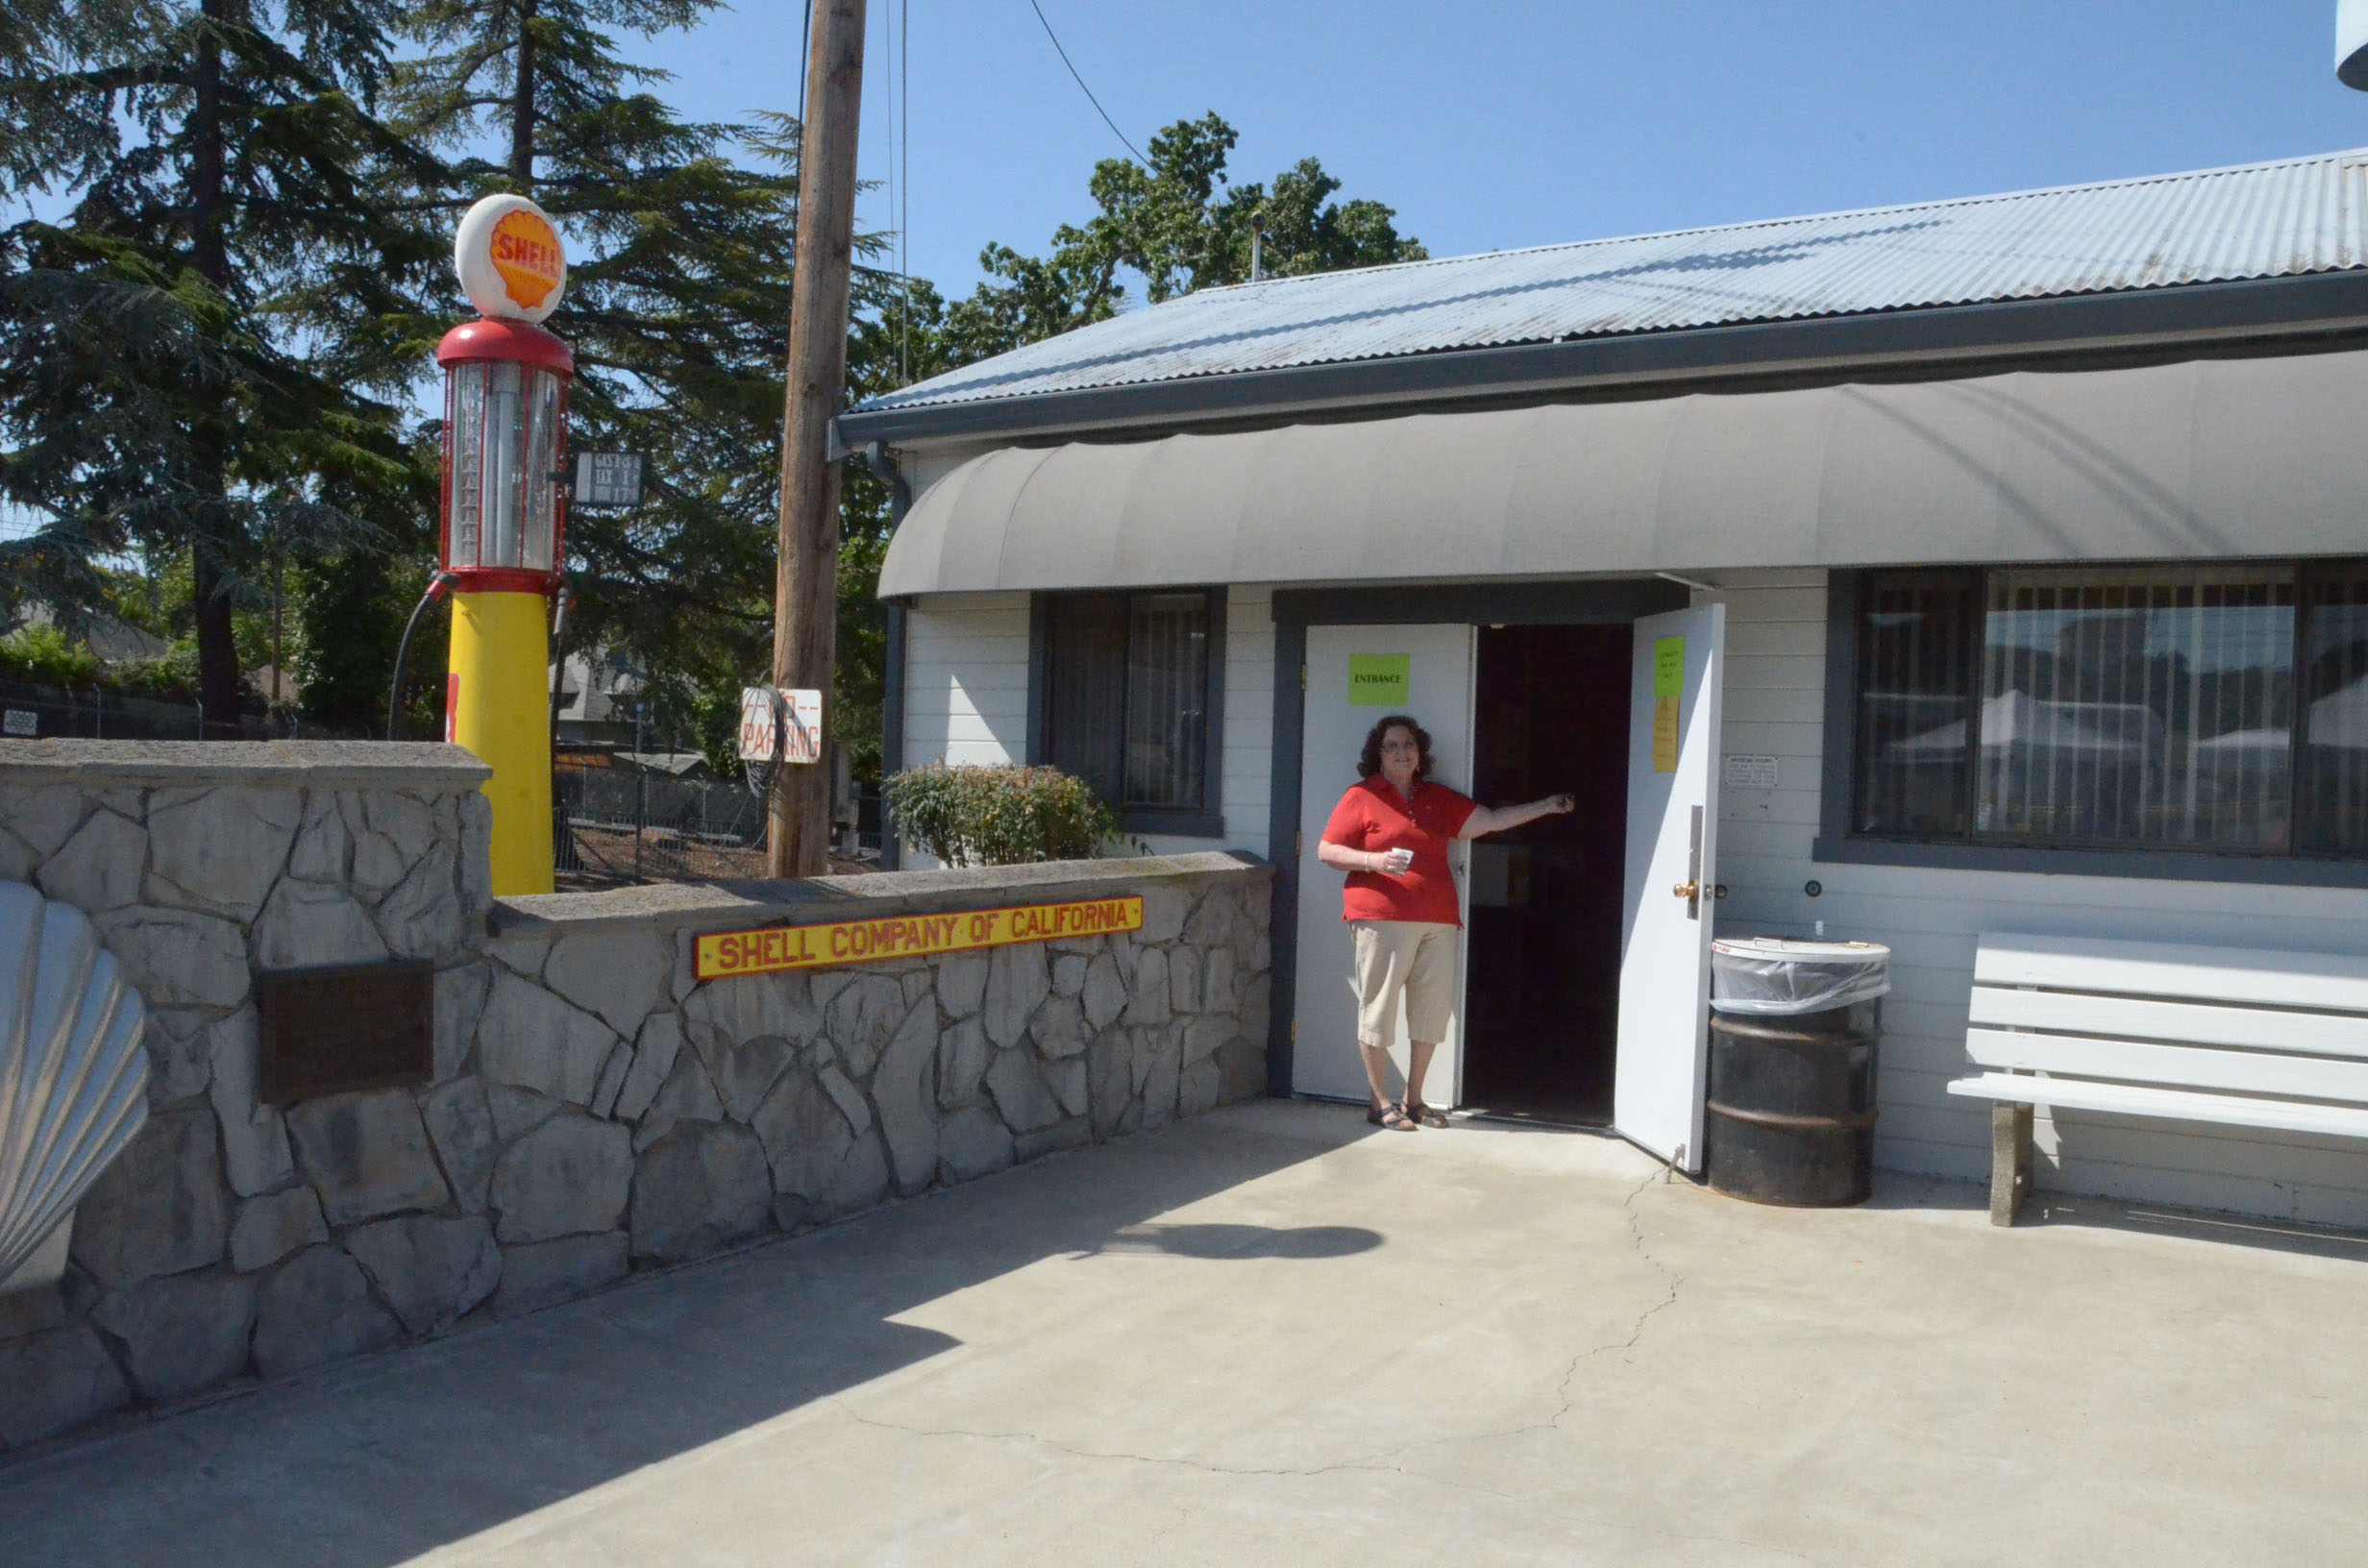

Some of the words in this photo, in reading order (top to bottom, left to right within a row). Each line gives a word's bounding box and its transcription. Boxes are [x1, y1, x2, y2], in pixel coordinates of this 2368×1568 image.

[497, 233, 557, 278] SHELL
[1354, 674, 1401, 683] ENTRANCE
[719, 931, 816, 969] SHELL
[832, 918, 957, 958] COMPANY
[971, 913, 999, 943] OF
[1011, 902, 1128, 938] CALIFORNIA
